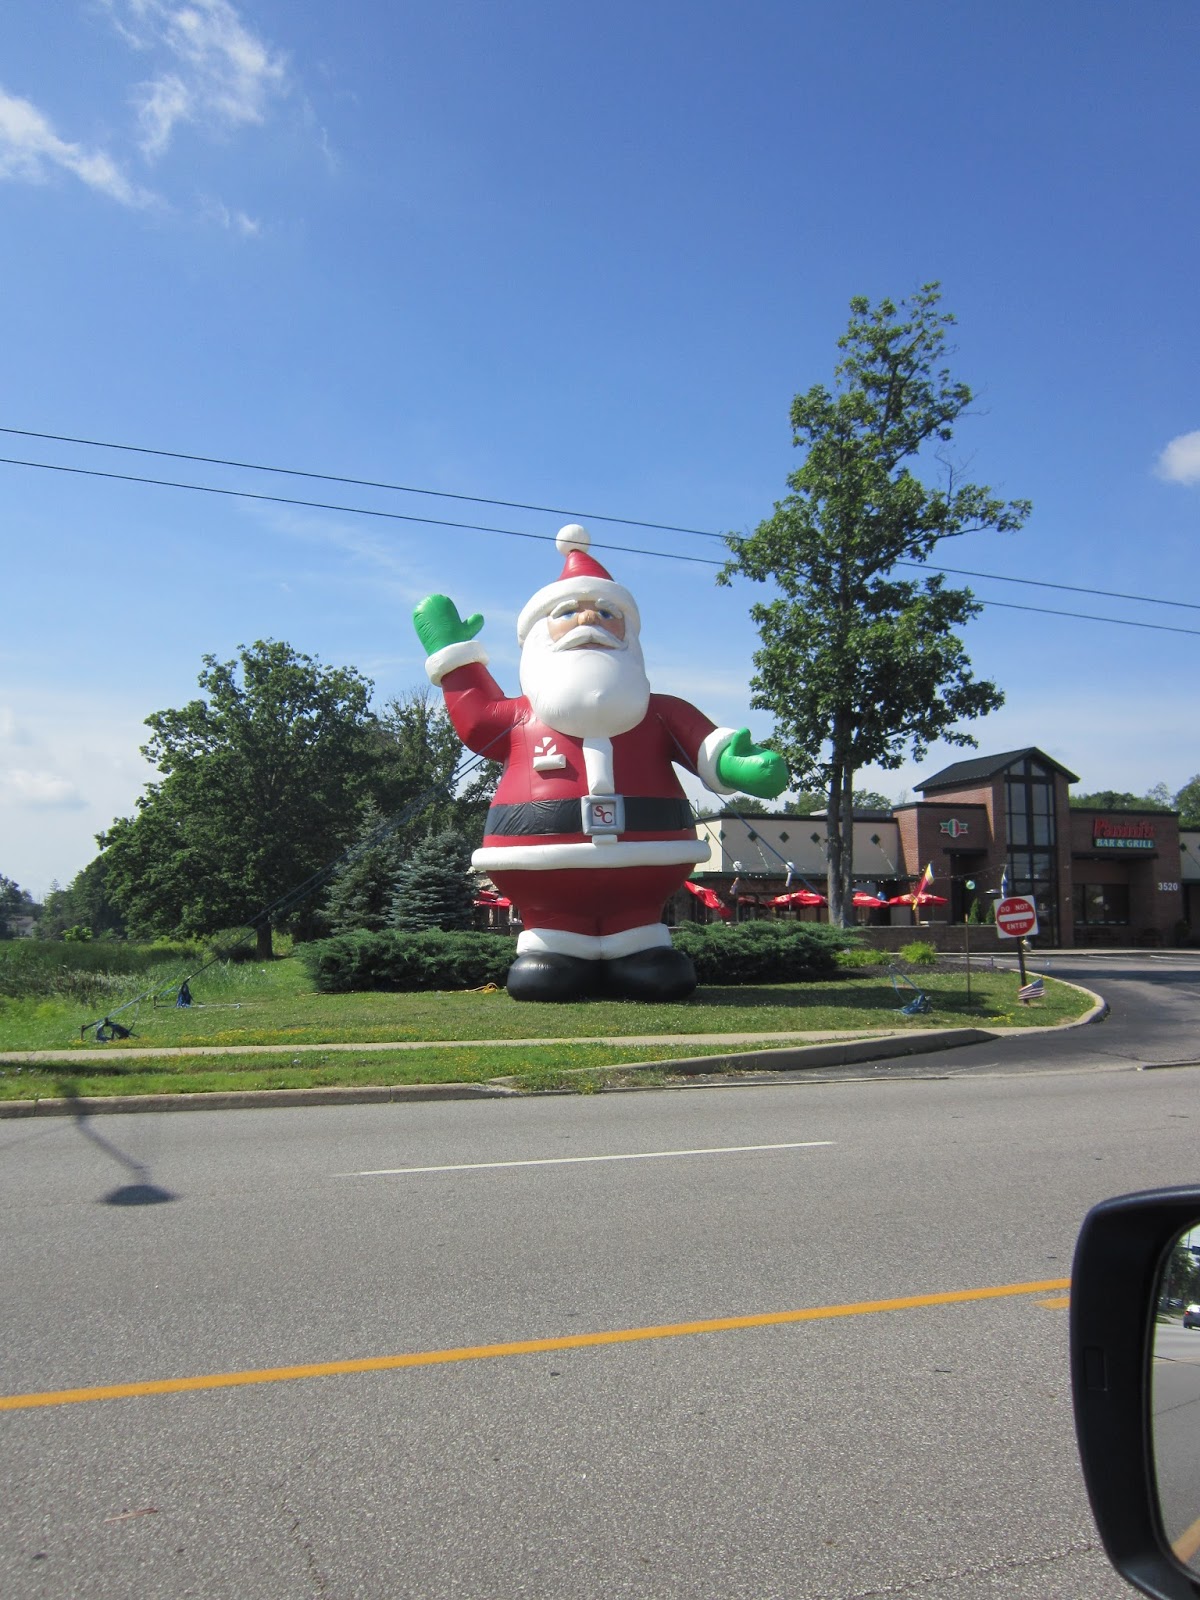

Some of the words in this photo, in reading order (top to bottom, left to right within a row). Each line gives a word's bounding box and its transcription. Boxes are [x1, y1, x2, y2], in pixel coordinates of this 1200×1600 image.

[1096, 838, 1115, 848] BAR
[1116, 838, 1125, 848] &
[1126, 839, 1153, 848] GRILL
[1158, 882, 1179, 891] 3520
[1006, 921, 1028, 930] ENTER
